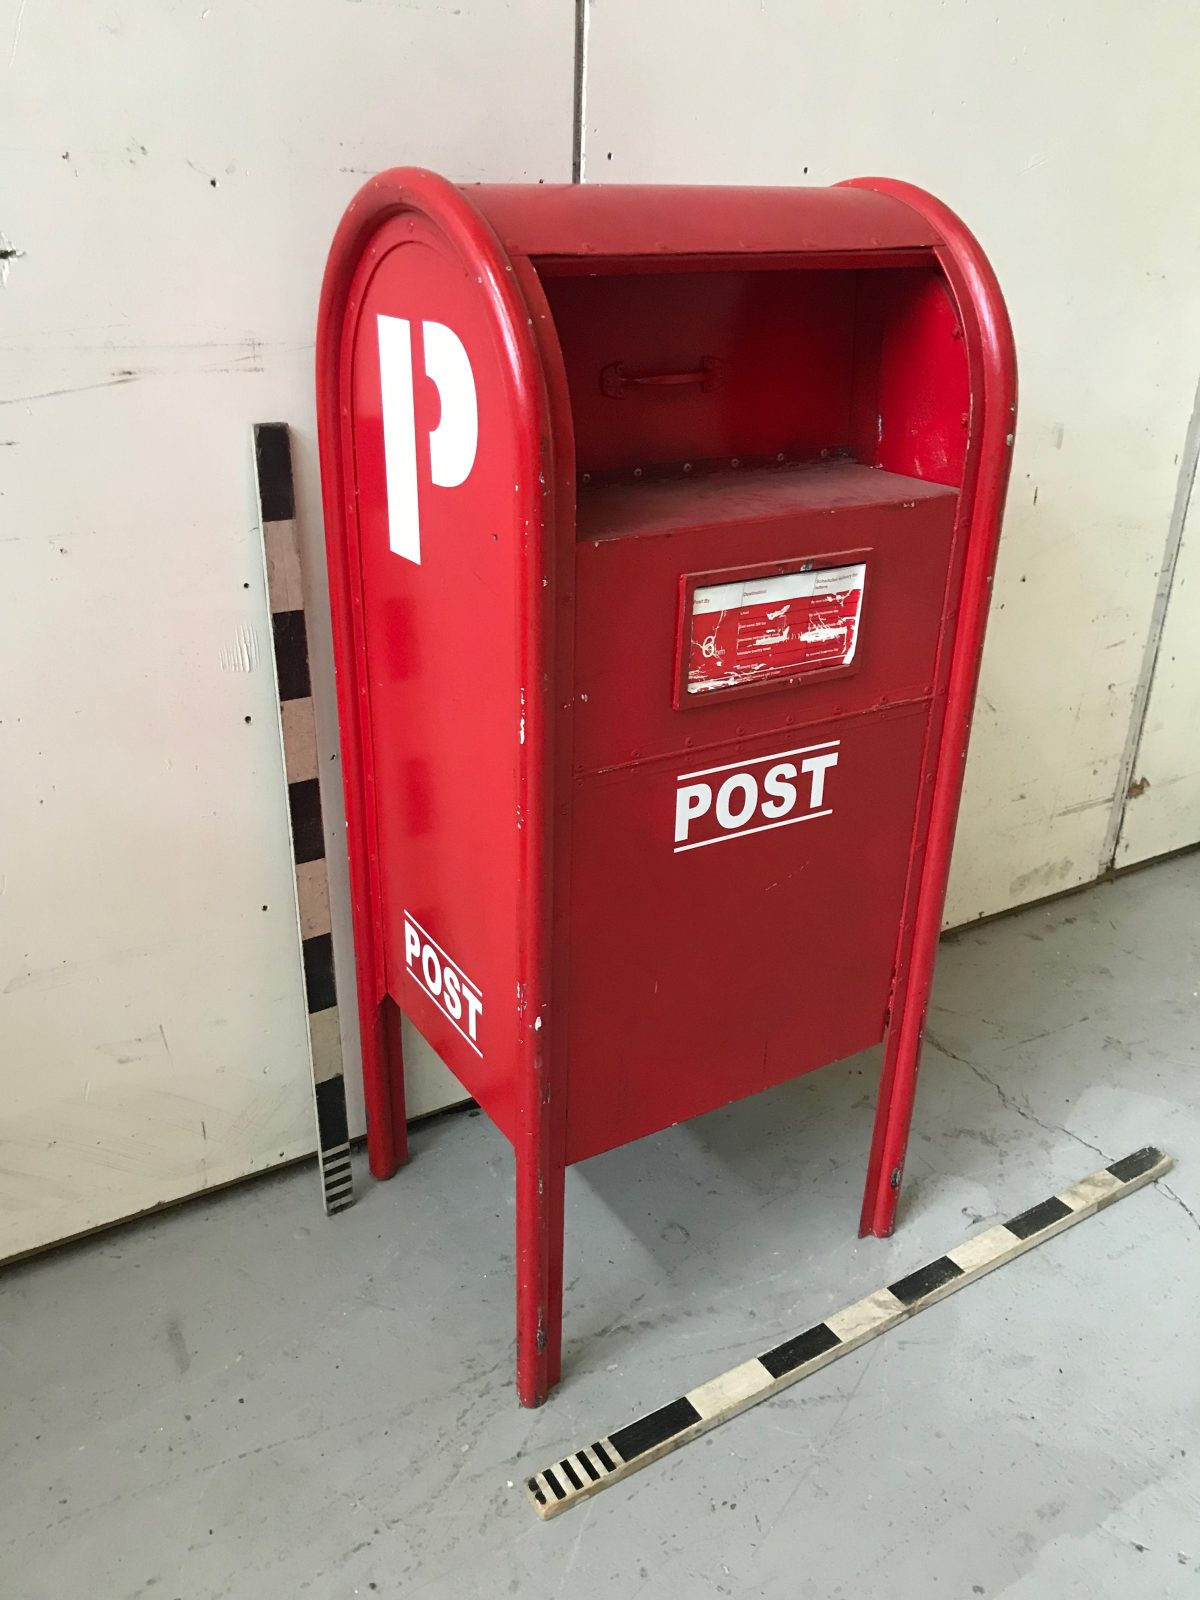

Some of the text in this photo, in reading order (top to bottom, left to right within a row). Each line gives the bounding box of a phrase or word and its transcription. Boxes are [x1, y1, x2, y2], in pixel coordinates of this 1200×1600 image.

[377, 314, 479, 566] P
[674, 752, 839, 842] POST
[405, 919, 483, 1042] POST
